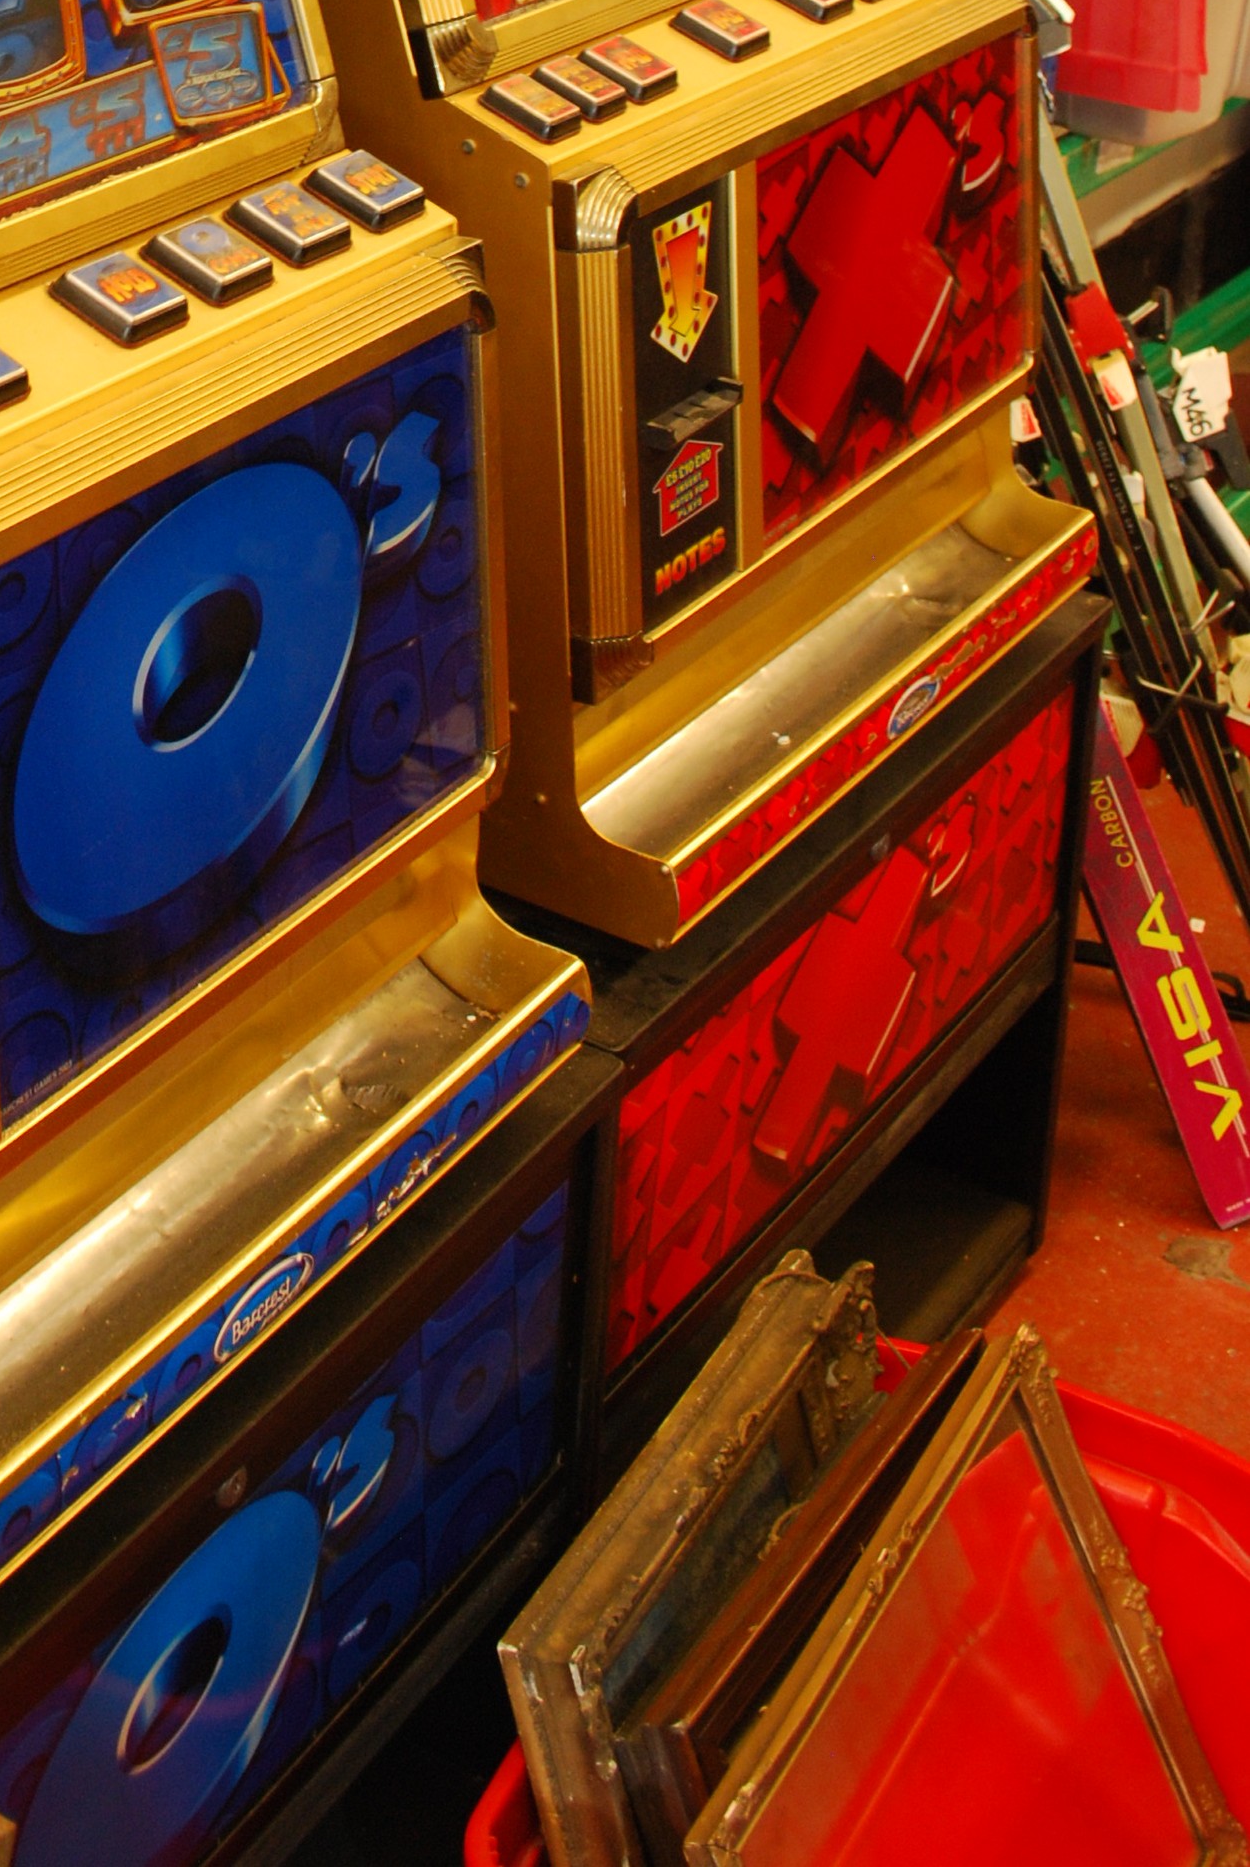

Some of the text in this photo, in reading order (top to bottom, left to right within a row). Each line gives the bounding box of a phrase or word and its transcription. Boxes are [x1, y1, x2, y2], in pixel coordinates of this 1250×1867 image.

[97, 267, 160, 306] HOLD
[1181, 387, 1213, 436] M46
[655, 526, 727, 596] NOTES
[1088, 775, 1135, 869] CARBON
[1136, 891, 1244, 1142] VISA
[232, 1275, 291, 1345] Barcrest
